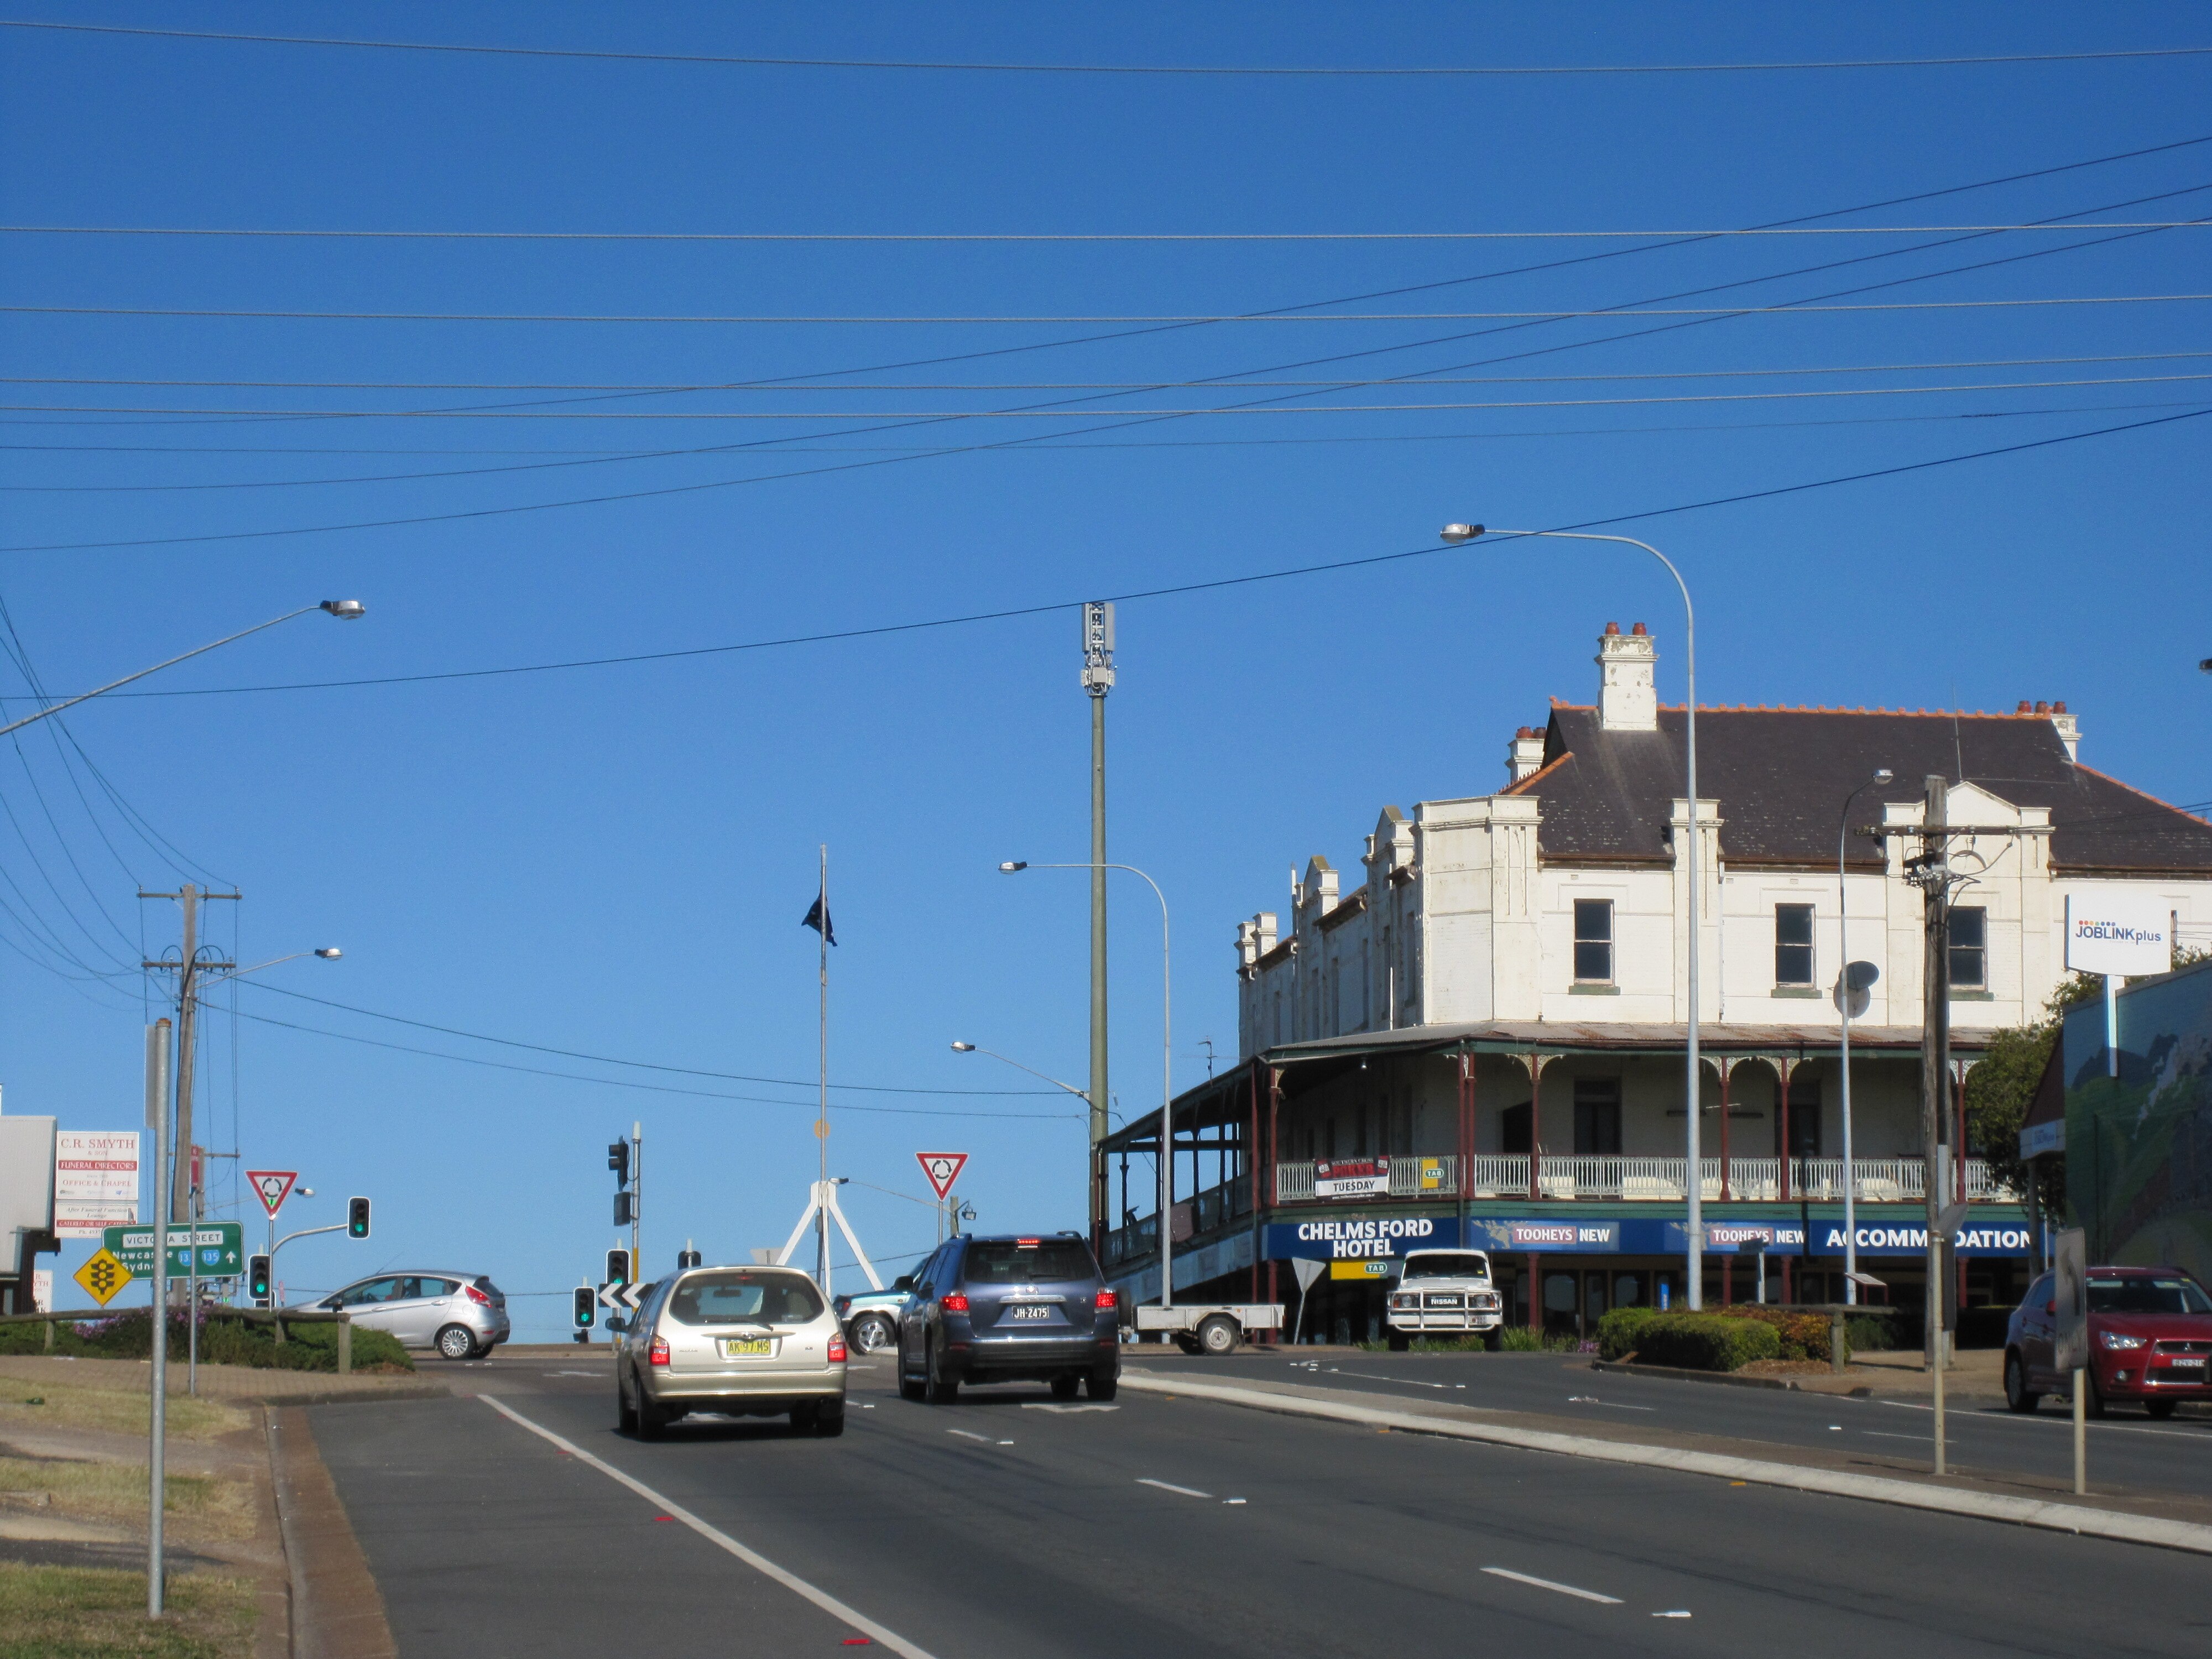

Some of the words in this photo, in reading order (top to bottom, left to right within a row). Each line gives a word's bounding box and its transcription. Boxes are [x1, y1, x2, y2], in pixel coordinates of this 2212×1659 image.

[2075, 926, 2162, 946] JOBLINKplus
[61, 1139, 84, 1149] C.R.
[88, 1139, 135, 1149] SMYTH
[1333, 1180, 1375, 1192] TUESDAY
[1298, 1219, 1433, 1240] CHELMSFORD
[1516, 1228, 1573, 1241] TOOHEYS
[1579, 1228, 1610, 1242] NEW
[1776, 1230, 1805, 1244] NEW
[1333, 1239, 1395, 1258] HOTEL
[204, 1253, 218, 1261] 135
